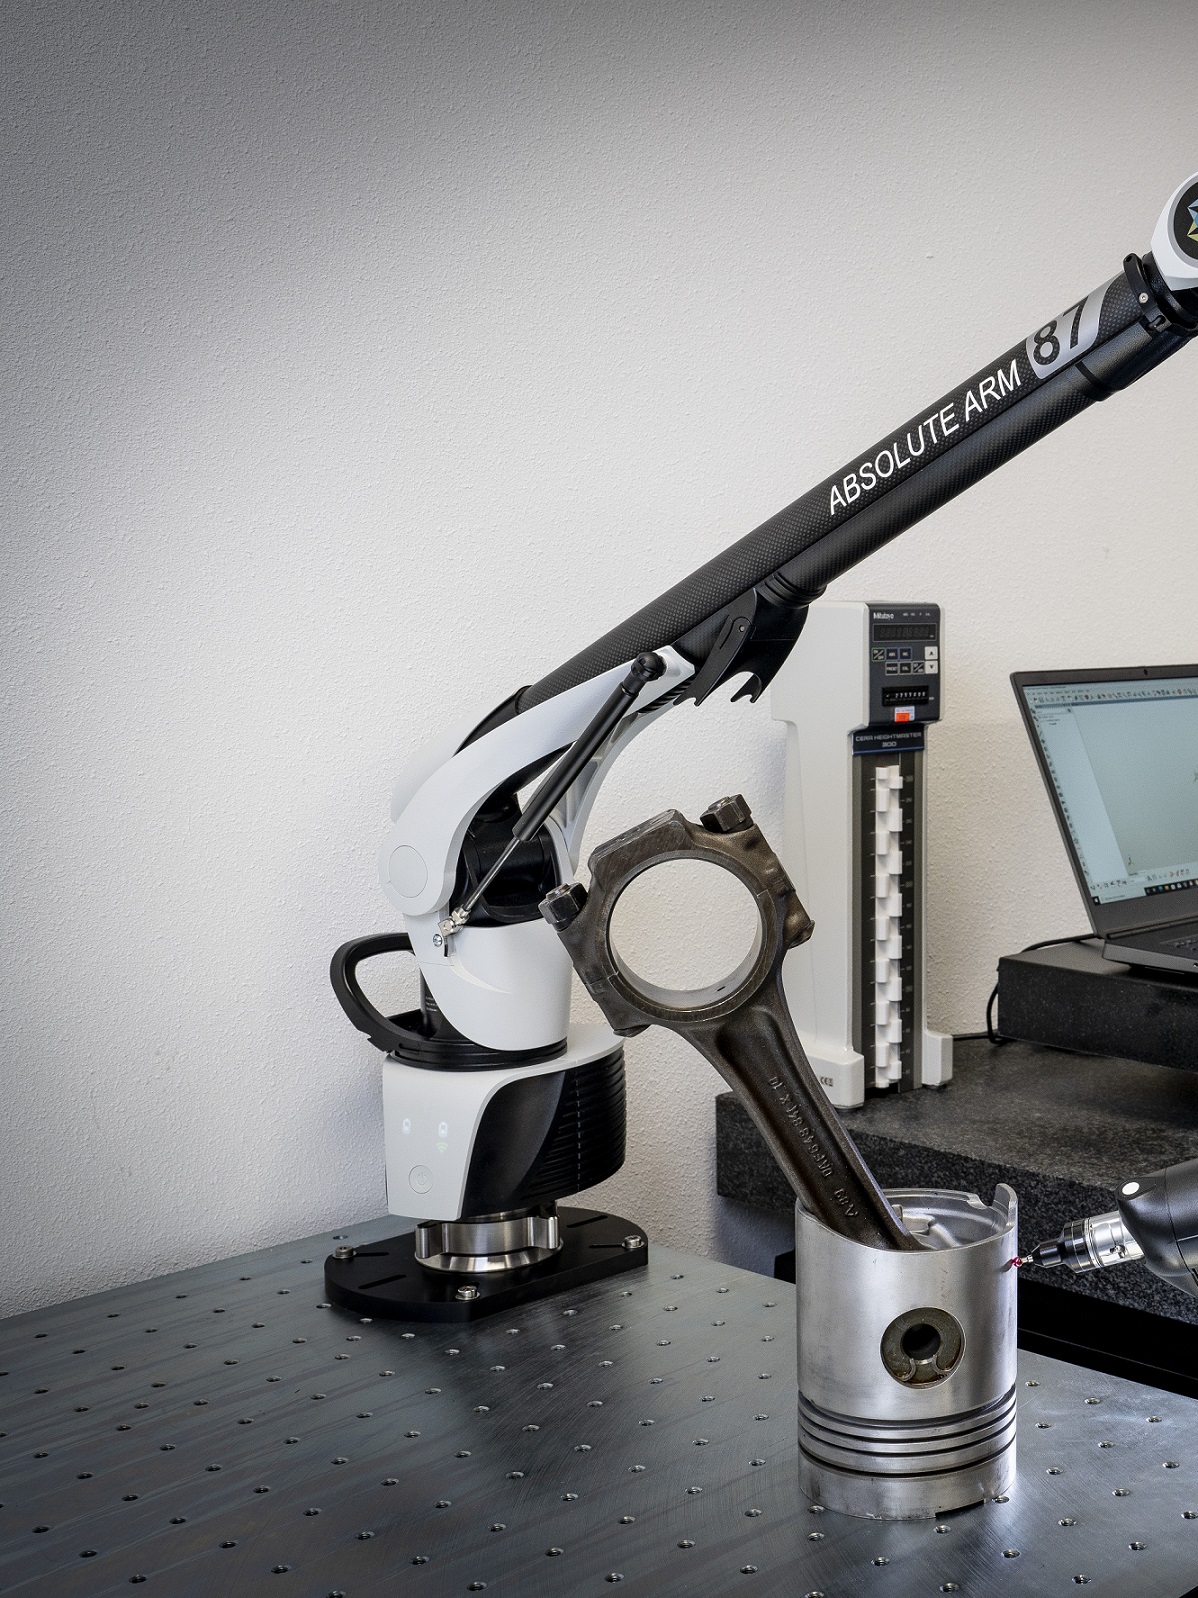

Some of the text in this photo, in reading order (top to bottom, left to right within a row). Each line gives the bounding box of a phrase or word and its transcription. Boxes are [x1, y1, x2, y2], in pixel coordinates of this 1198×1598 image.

[829, 295, 1089, 516] ABSOLUTE ARM 87
[874, 732, 922, 740] HEIGHTMASTER
